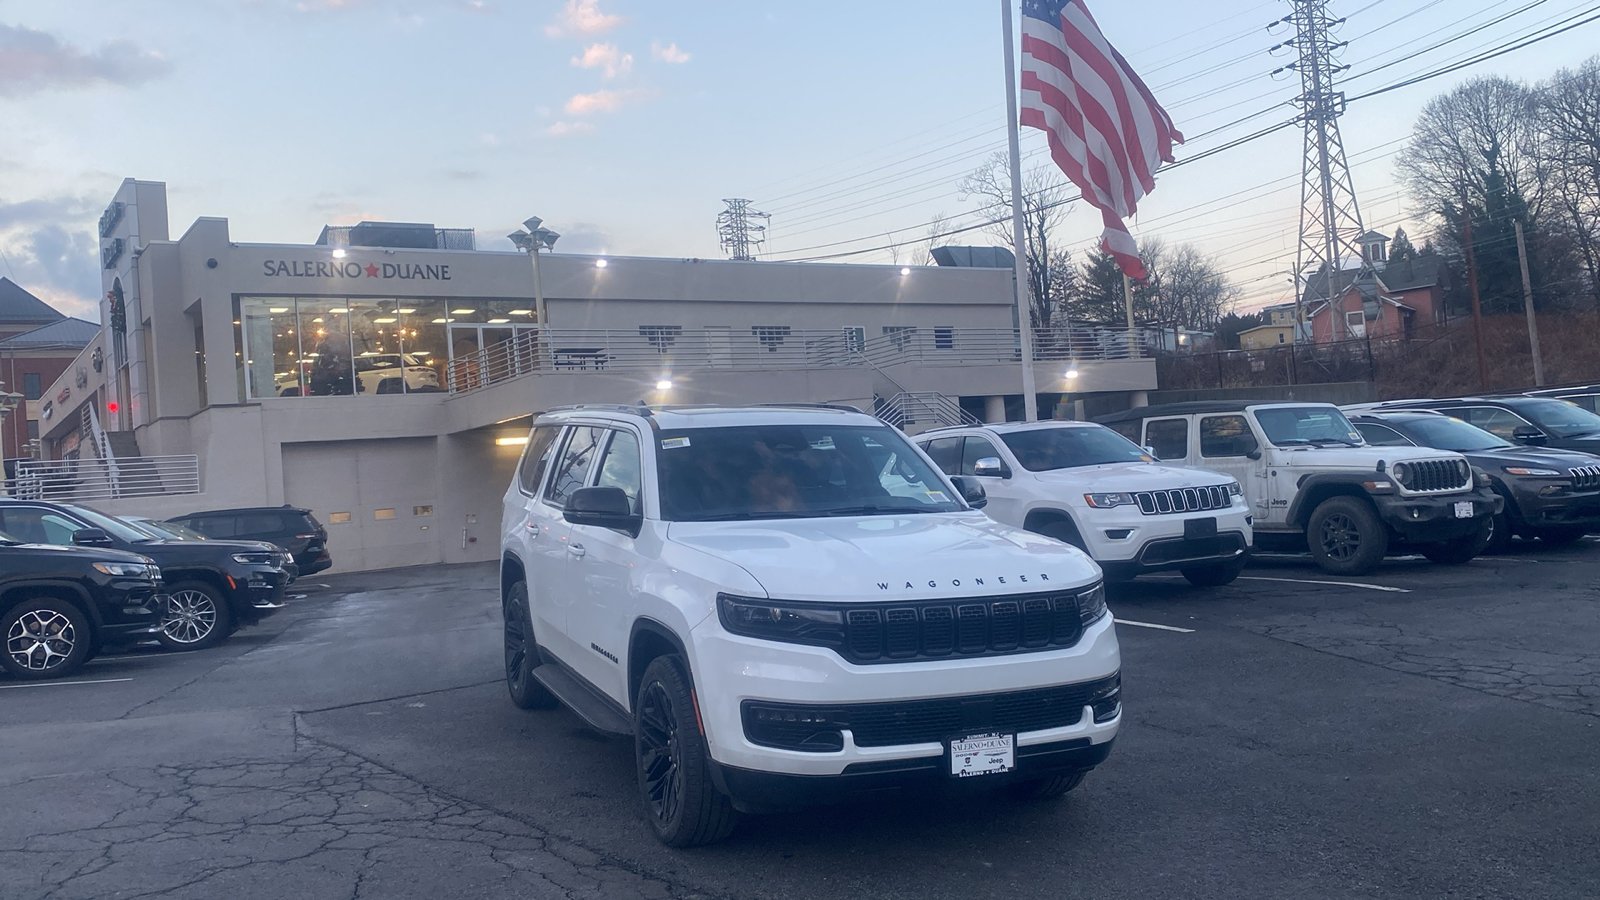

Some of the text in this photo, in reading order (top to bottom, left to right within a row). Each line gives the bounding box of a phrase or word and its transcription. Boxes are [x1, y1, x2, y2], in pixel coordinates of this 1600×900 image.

[263, 260, 451, 280] SALERNO DUANE
[1271, 498, 1287, 506] Jeep
[877, 573, 1049, 590] WAGONEER
[952, 742, 984, 751] SALERNO
[986, 739, 1011, 748] DUANE
